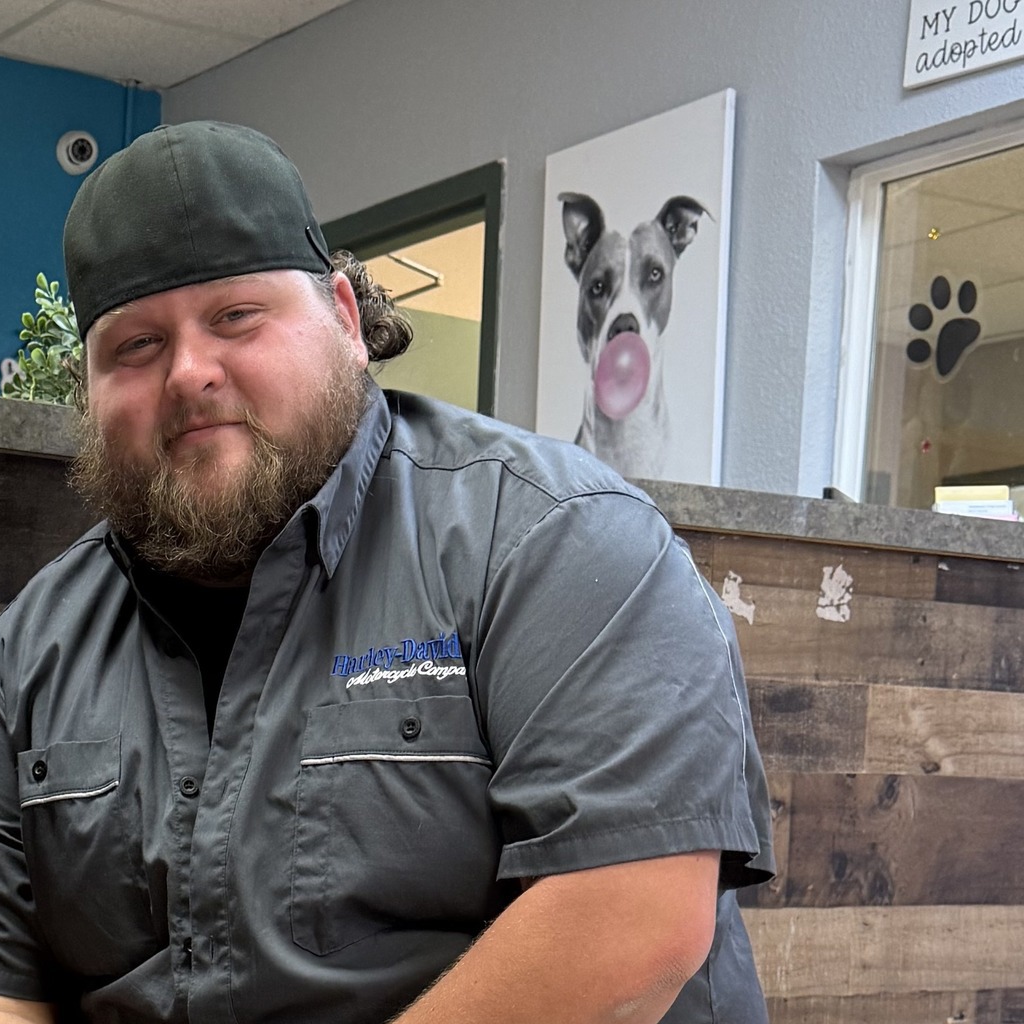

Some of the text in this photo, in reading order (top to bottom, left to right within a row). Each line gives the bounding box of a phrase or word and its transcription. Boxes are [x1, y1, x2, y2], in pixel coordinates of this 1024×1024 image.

[920, 6, 957, 40] MY
[916, 18, 1022, 73] adopted
[330, 631, 463, 677] Harley-David
[417, 660, 467, 681] Compa
